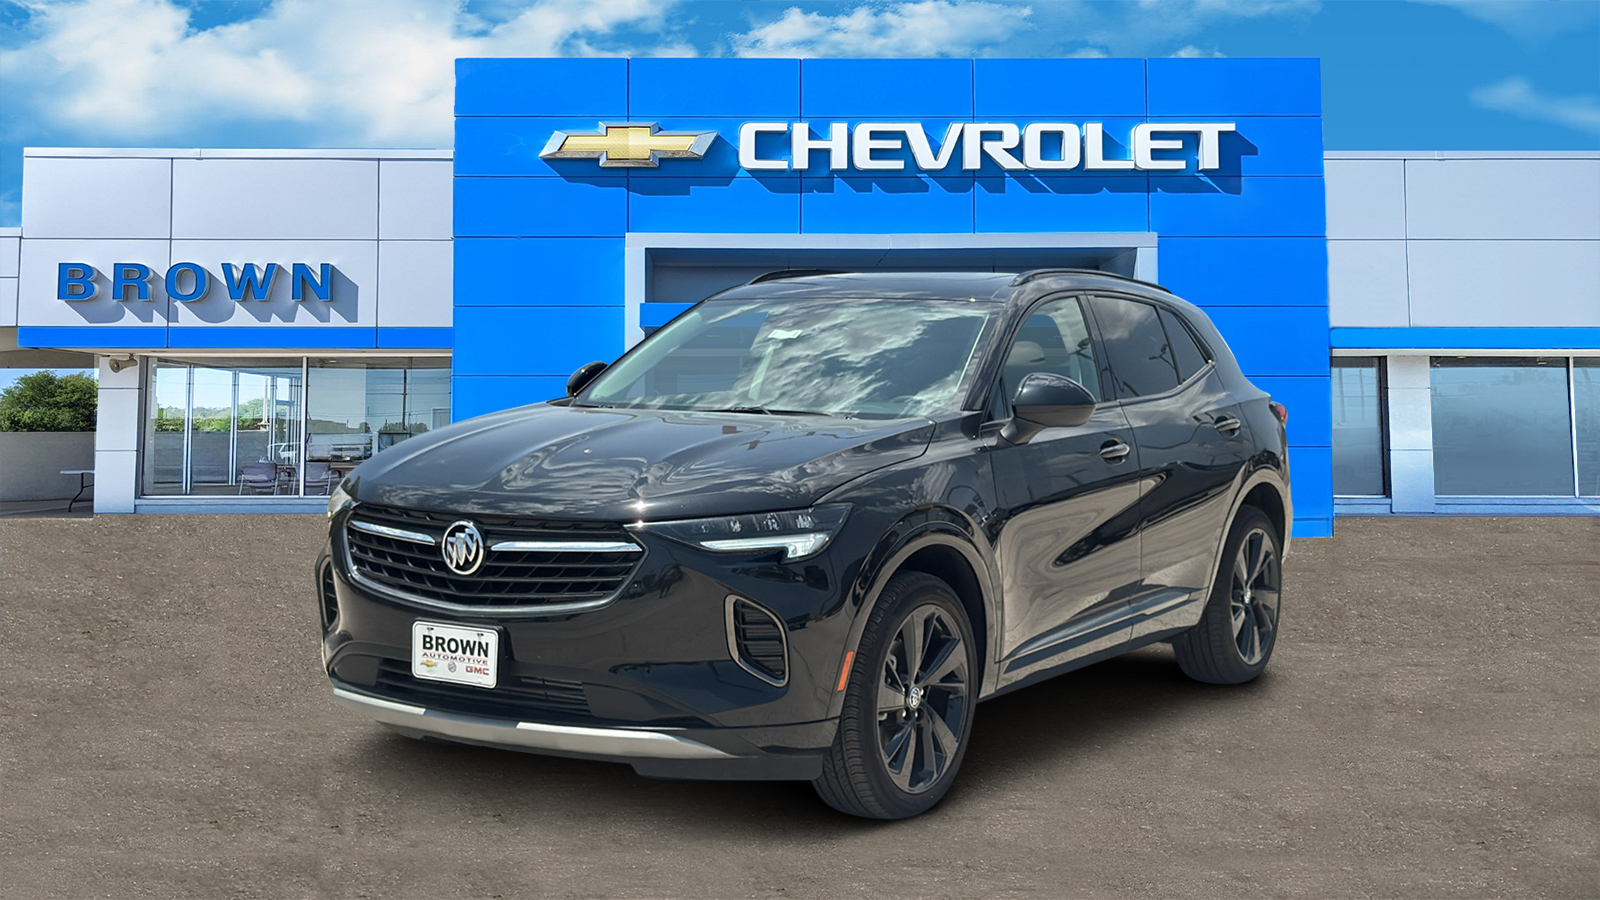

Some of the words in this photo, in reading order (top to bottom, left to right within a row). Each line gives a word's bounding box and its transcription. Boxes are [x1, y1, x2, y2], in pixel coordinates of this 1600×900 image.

[738, 122, 1236, 171] CHEVROLET
[57, 262, 334, 302] BROWN
[422, 635, 489, 658] BROWN
[422, 652, 488, 664] AUTOMOTIVE
[465, 666, 490, 675] GMC
